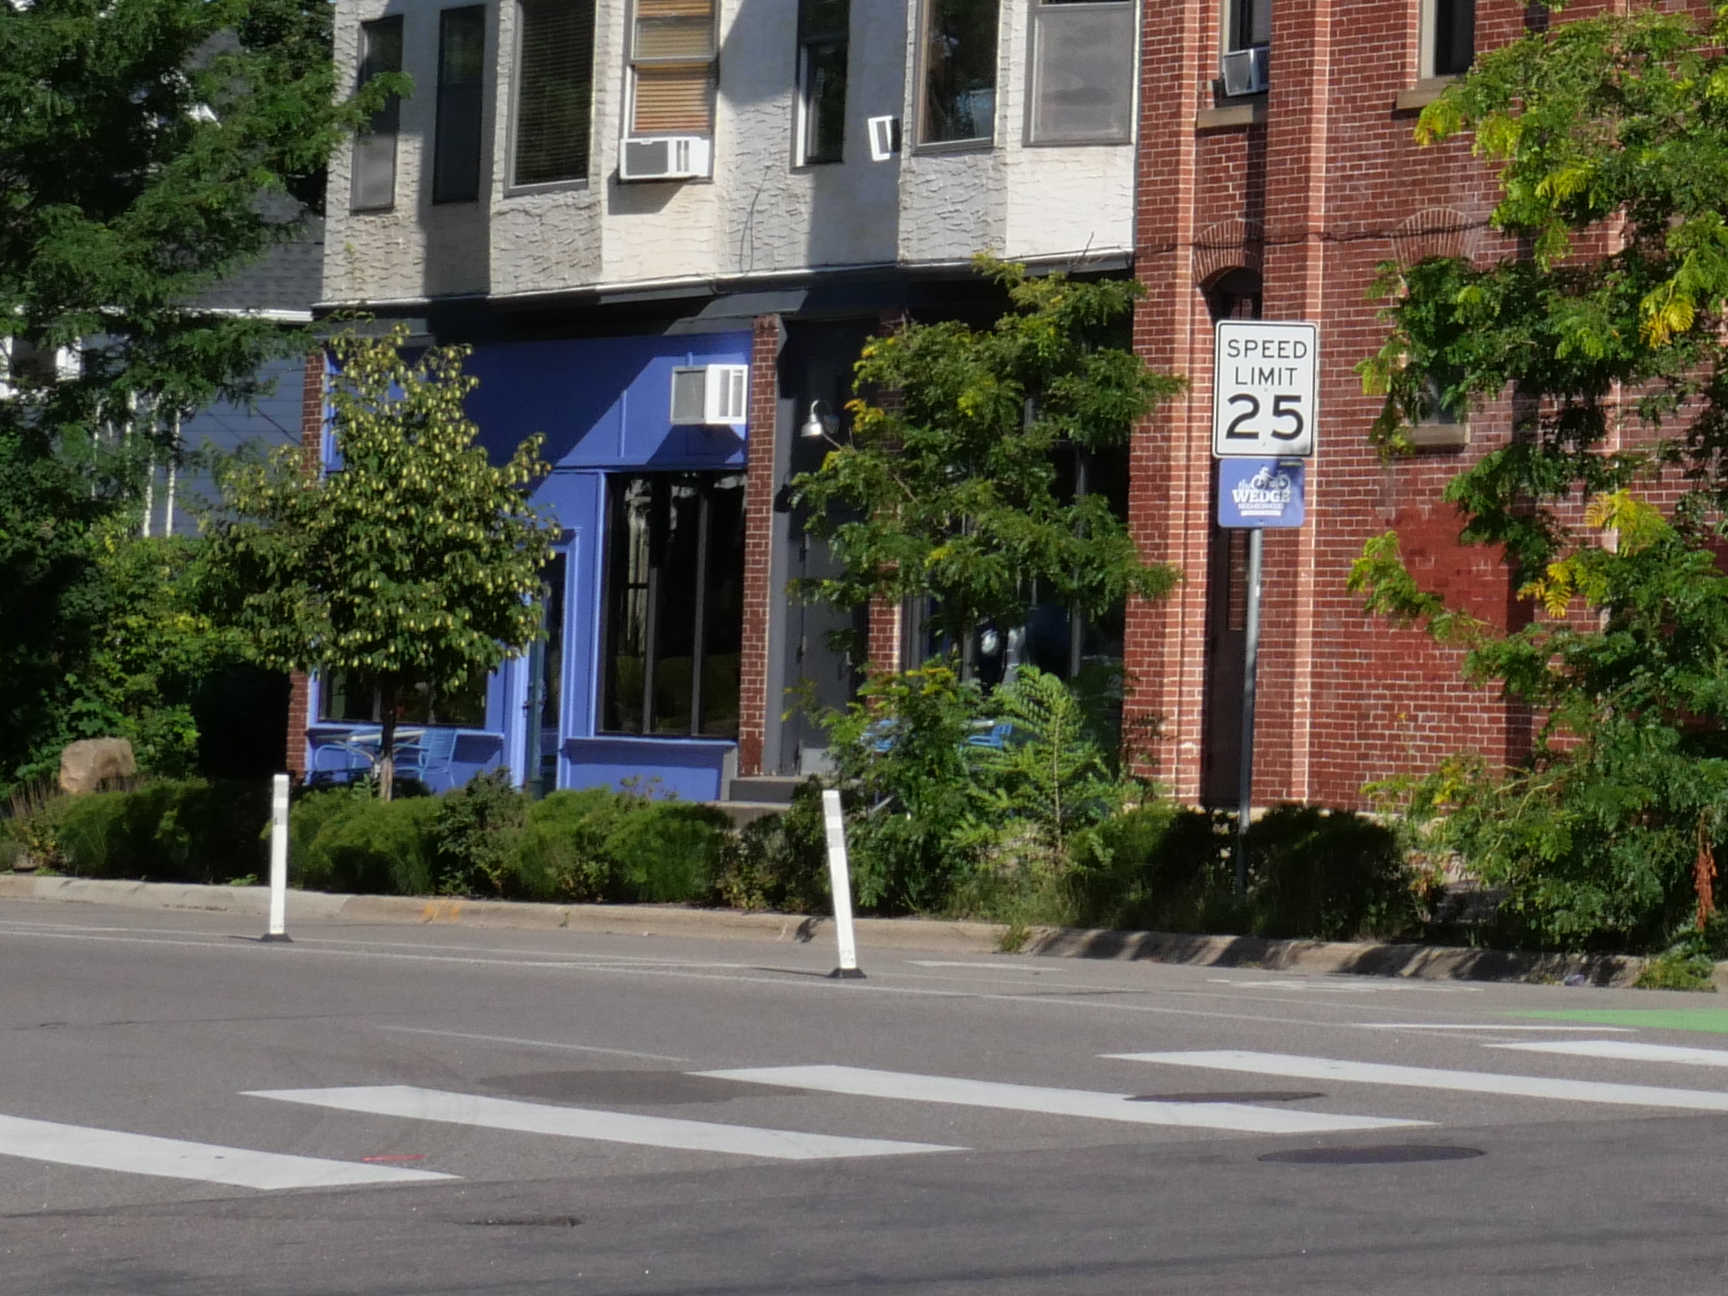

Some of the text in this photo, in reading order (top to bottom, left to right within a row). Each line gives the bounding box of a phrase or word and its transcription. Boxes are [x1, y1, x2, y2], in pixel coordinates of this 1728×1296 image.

[1227, 339, 1307, 359] SPEED
[1235, 366, 1298, 386] LIMIT
[1225, 392, 1304, 441] 25
[1232, 490, 1290, 503] WEDGE
